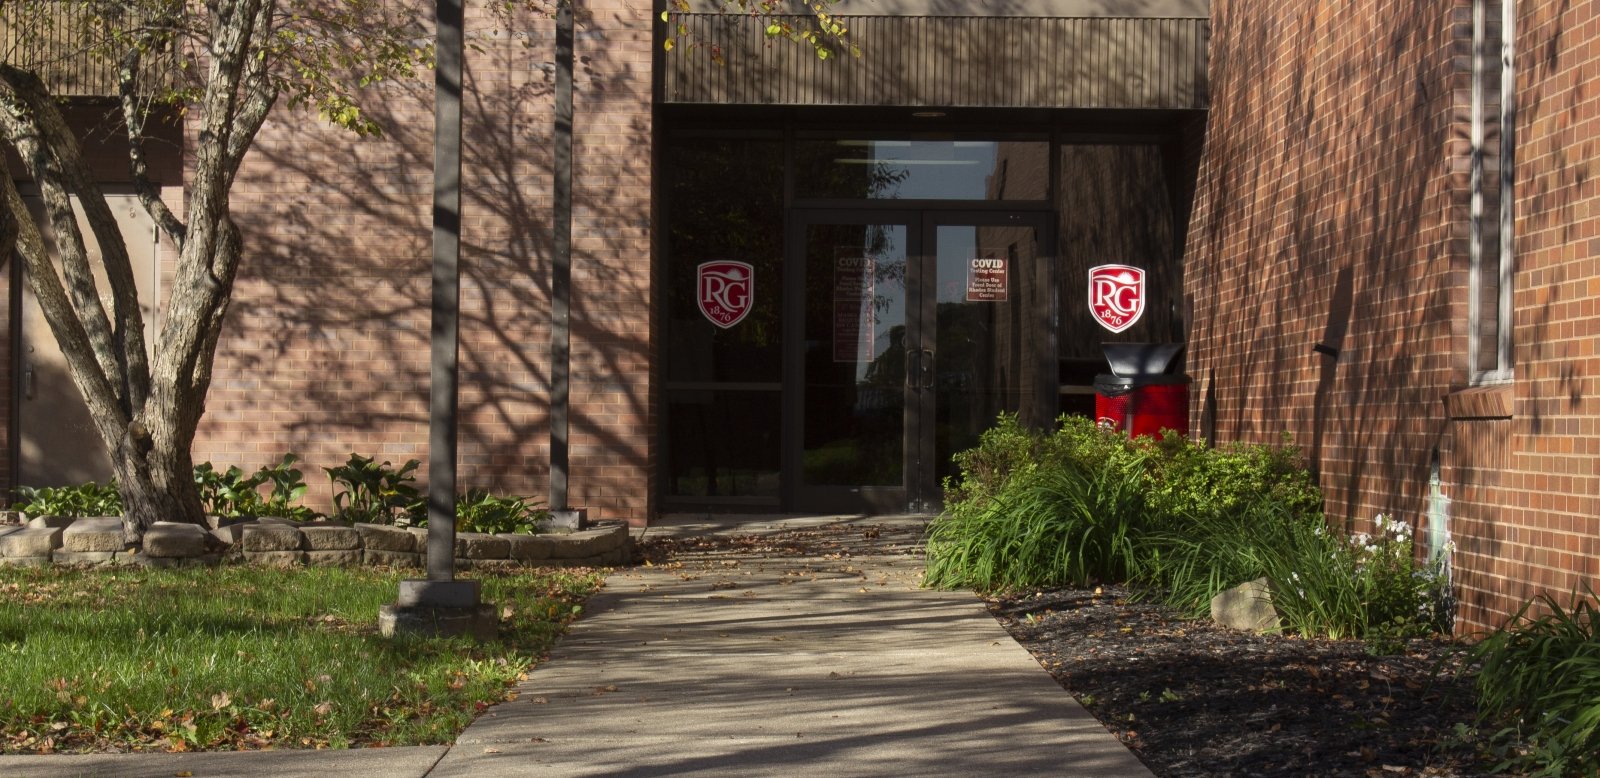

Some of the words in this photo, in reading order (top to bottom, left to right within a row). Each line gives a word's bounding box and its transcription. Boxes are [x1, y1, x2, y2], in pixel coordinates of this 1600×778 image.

[971, 258, 1004, 268] COVID
[703, 276, 748, 313] RG
[1094, 280, 1140, 317] RG
[710, 305, 731, 322] 1876
[1100, 309, 1122, 325] 1876
